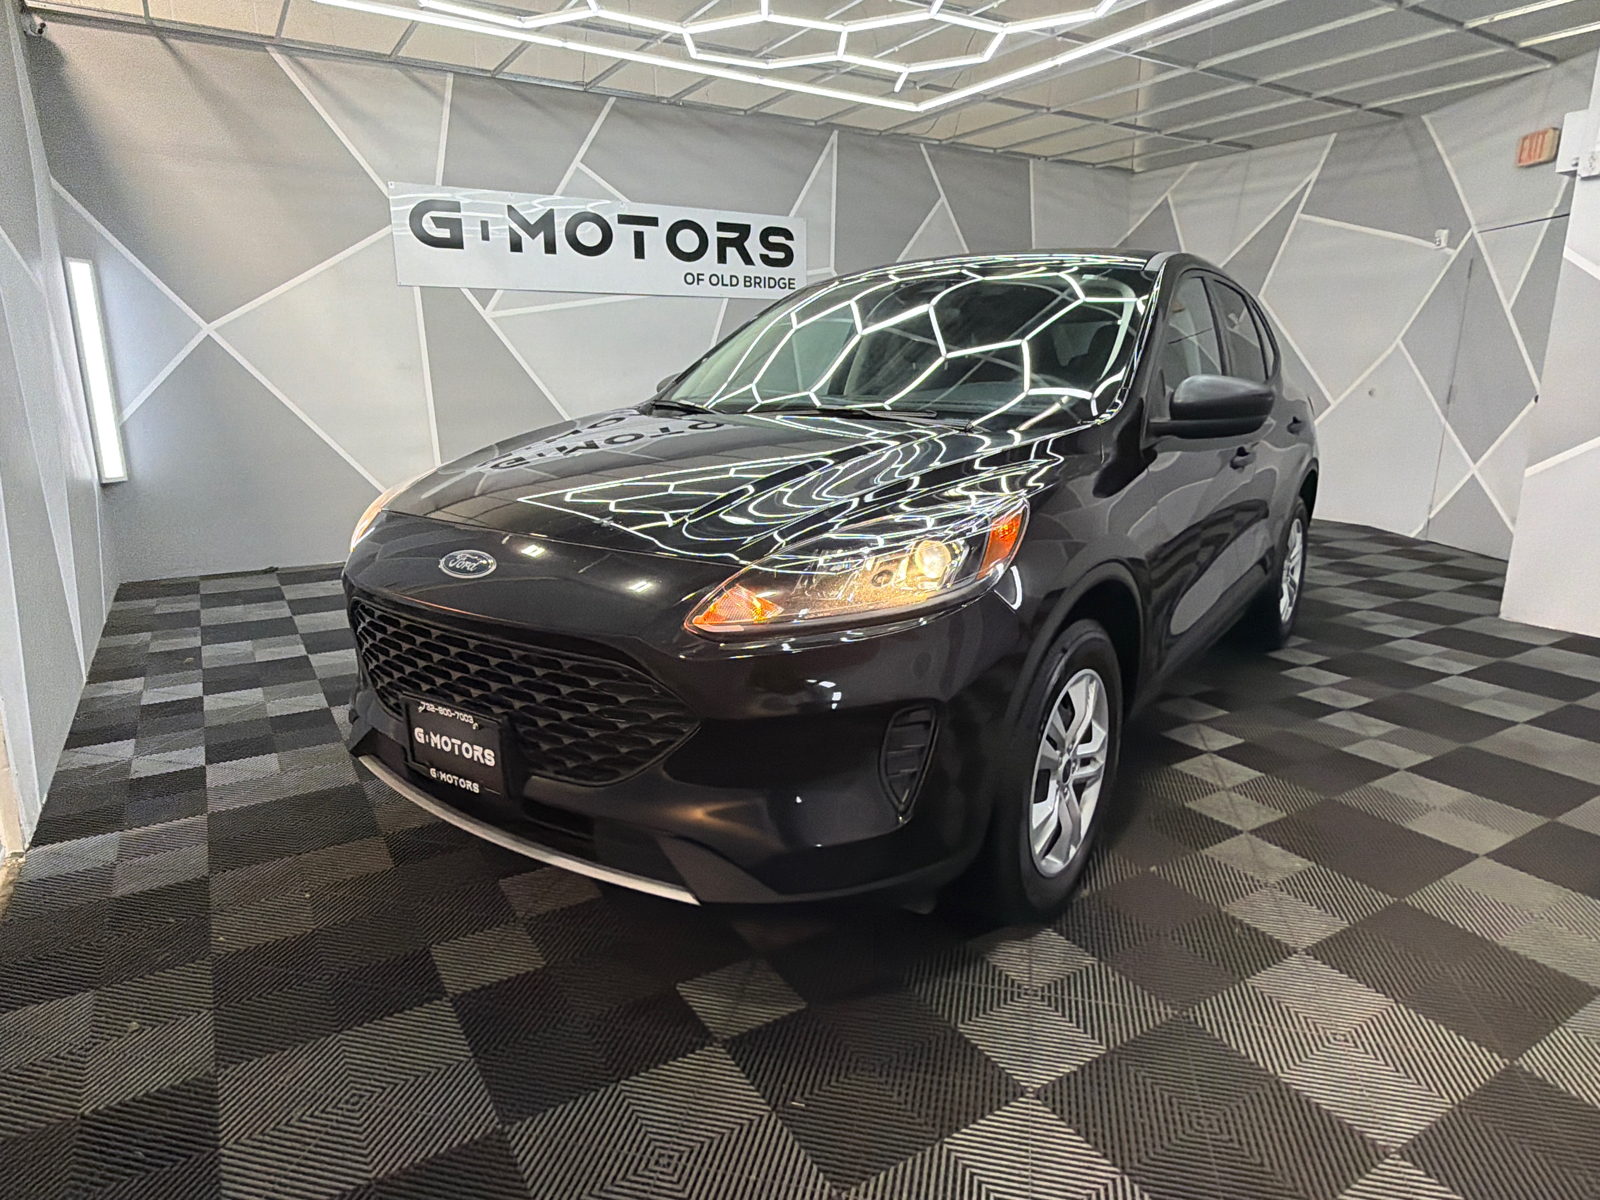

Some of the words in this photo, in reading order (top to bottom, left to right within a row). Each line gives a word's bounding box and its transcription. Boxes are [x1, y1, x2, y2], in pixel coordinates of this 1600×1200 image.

[683, 272, 705, 286] OF
[708, 273, 740, 288] OLD
[743, 275, 796, 290] BRIDGE
[448, 554, 479, 571] Ford
